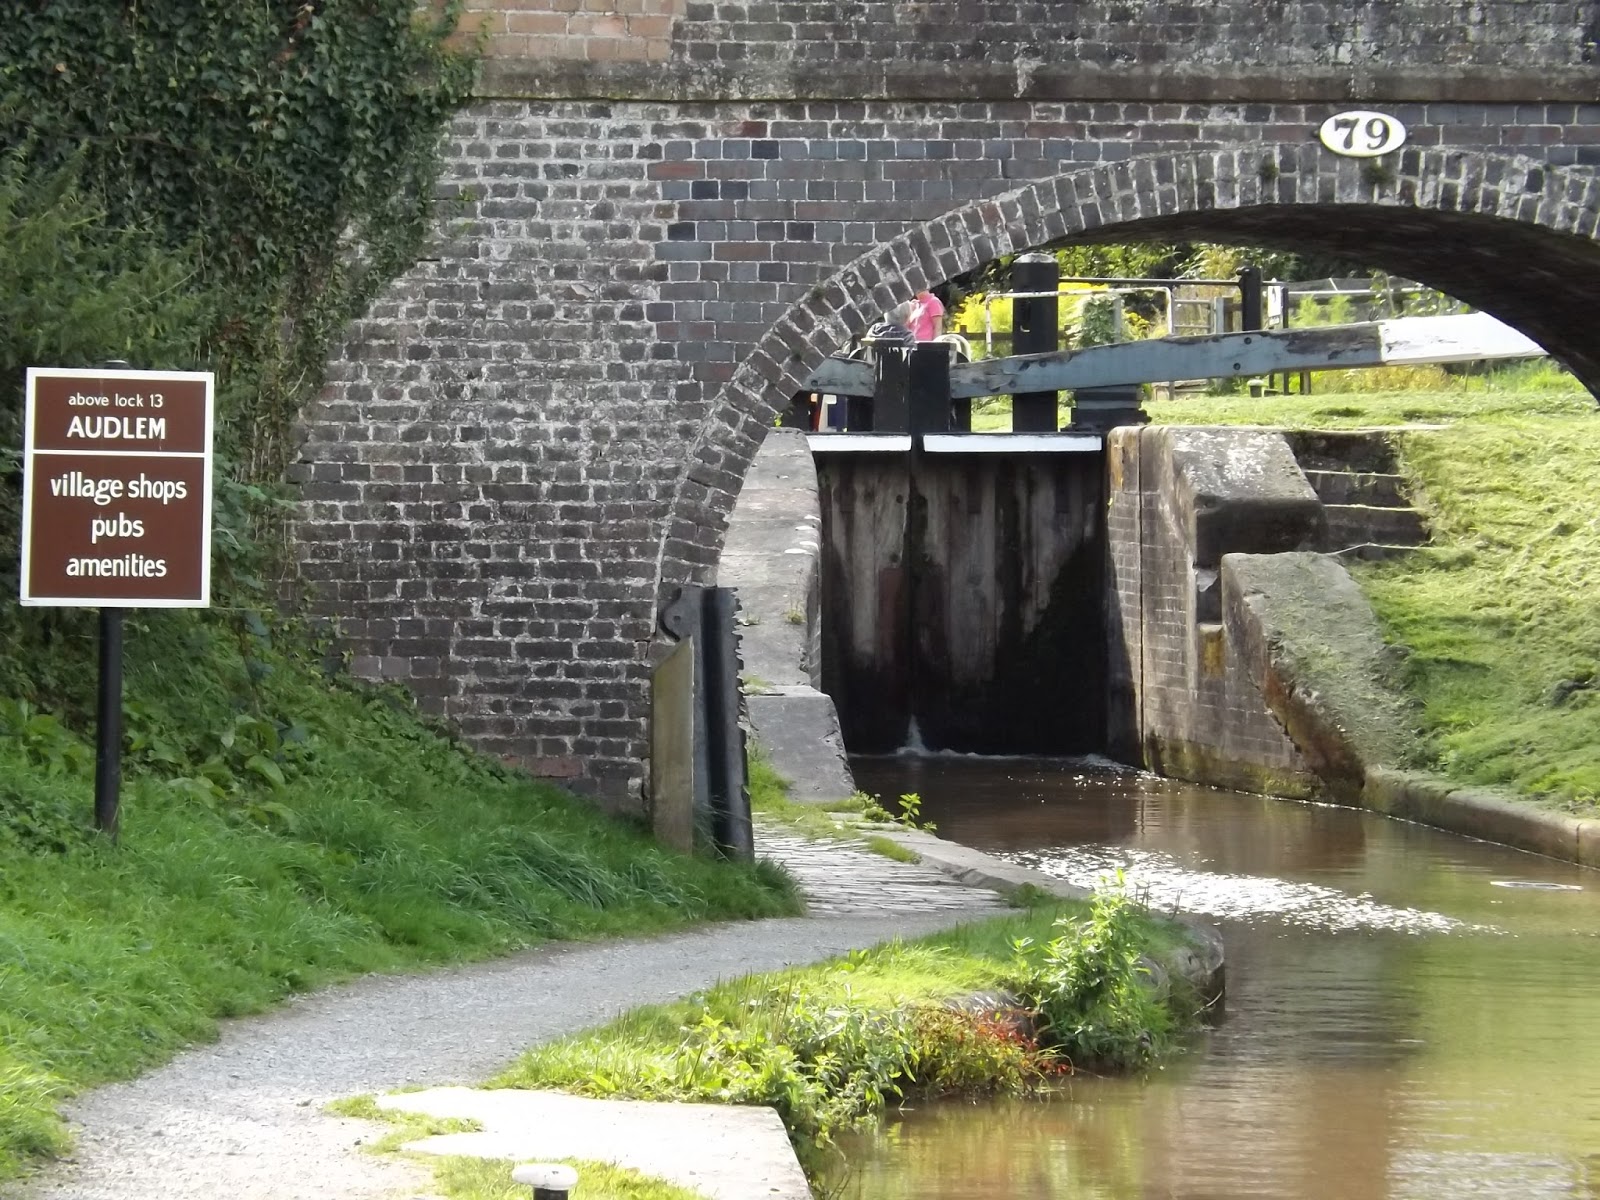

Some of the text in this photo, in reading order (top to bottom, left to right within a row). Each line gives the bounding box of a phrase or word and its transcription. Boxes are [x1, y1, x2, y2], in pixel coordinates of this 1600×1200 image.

[1334, 117, 1391, 150] 79
[68, 392, 163, 408] above lock 13
[66, 415, 165, 439] AUDLEM
[50, 471, 187, 505] village shops
[91, 511, 144, 544] pubs
[65, 553, 167, 577] amenities
